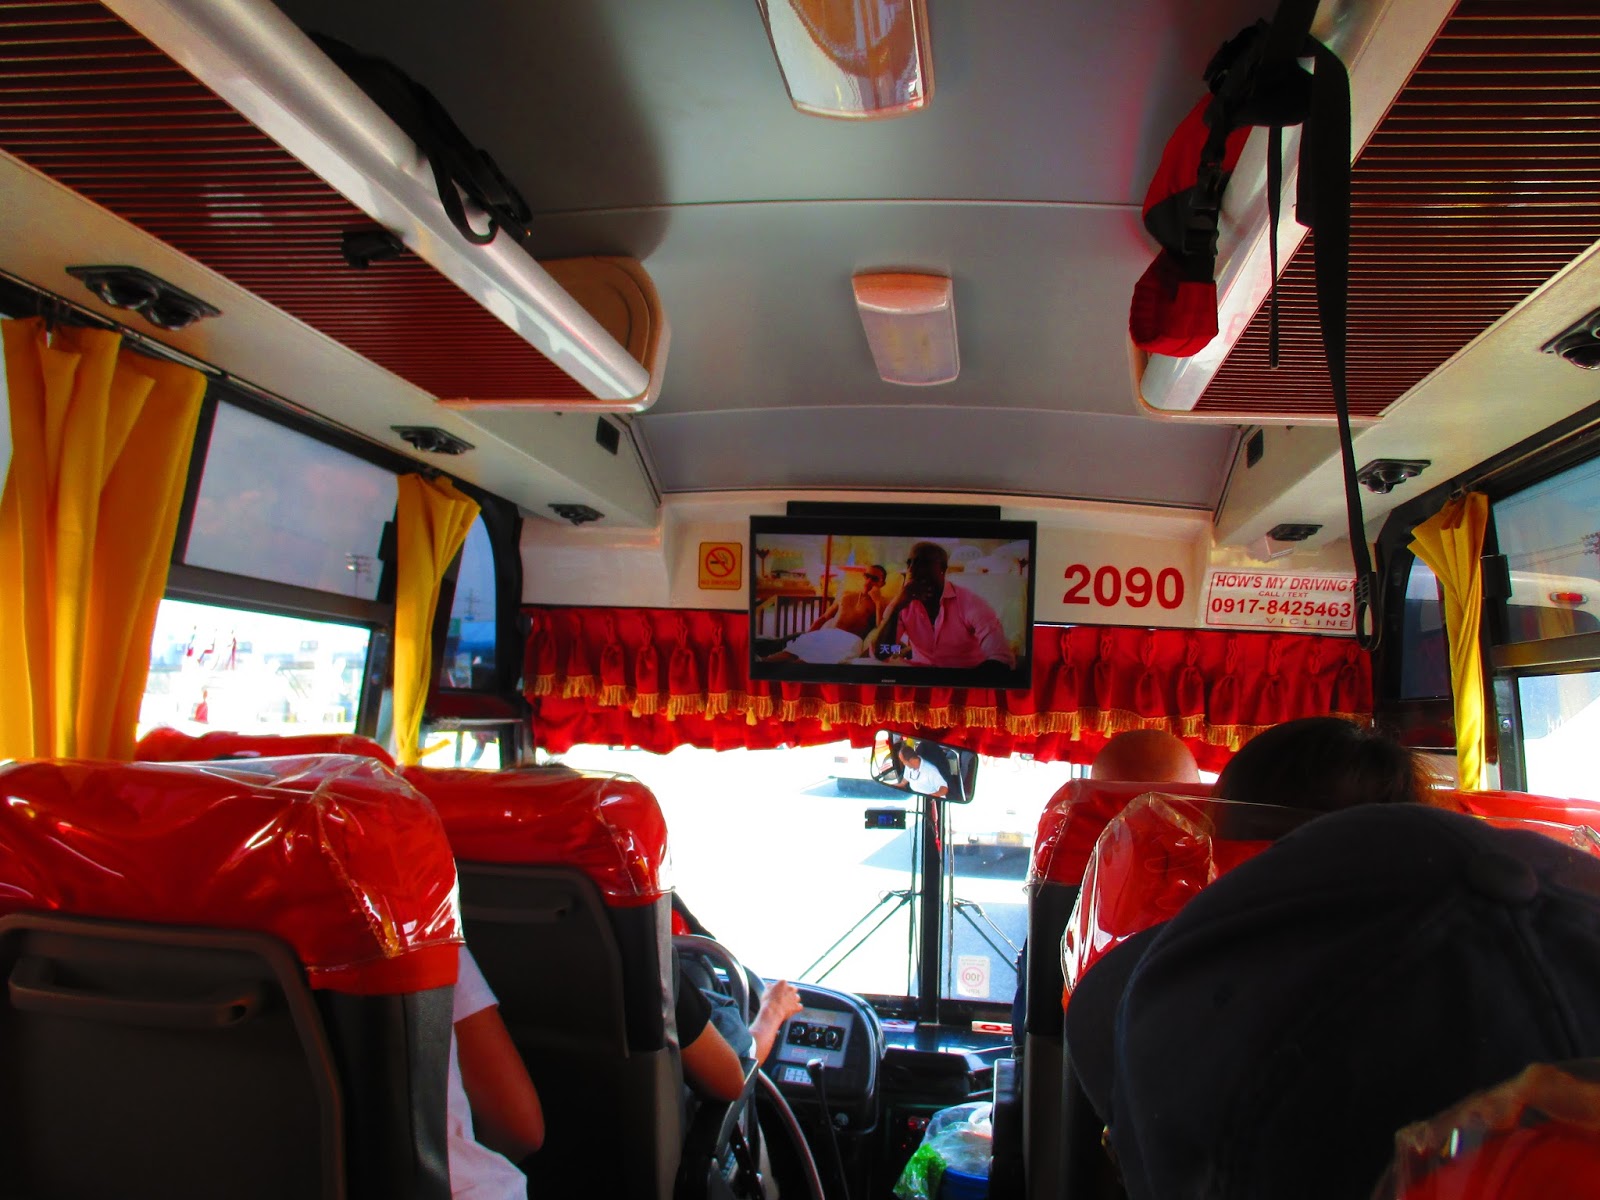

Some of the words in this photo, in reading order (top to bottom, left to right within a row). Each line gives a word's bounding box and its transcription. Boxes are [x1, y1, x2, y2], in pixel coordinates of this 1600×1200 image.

[1063, 563, 1185, 610] 2090
[1216, 574, 1263, 589] HOW'S
[1266, 576, 1288, 590] MY
[1211, 598, 1351, 618] 0917-8425463
[1266, 617, 1350, 628] VICLINE
